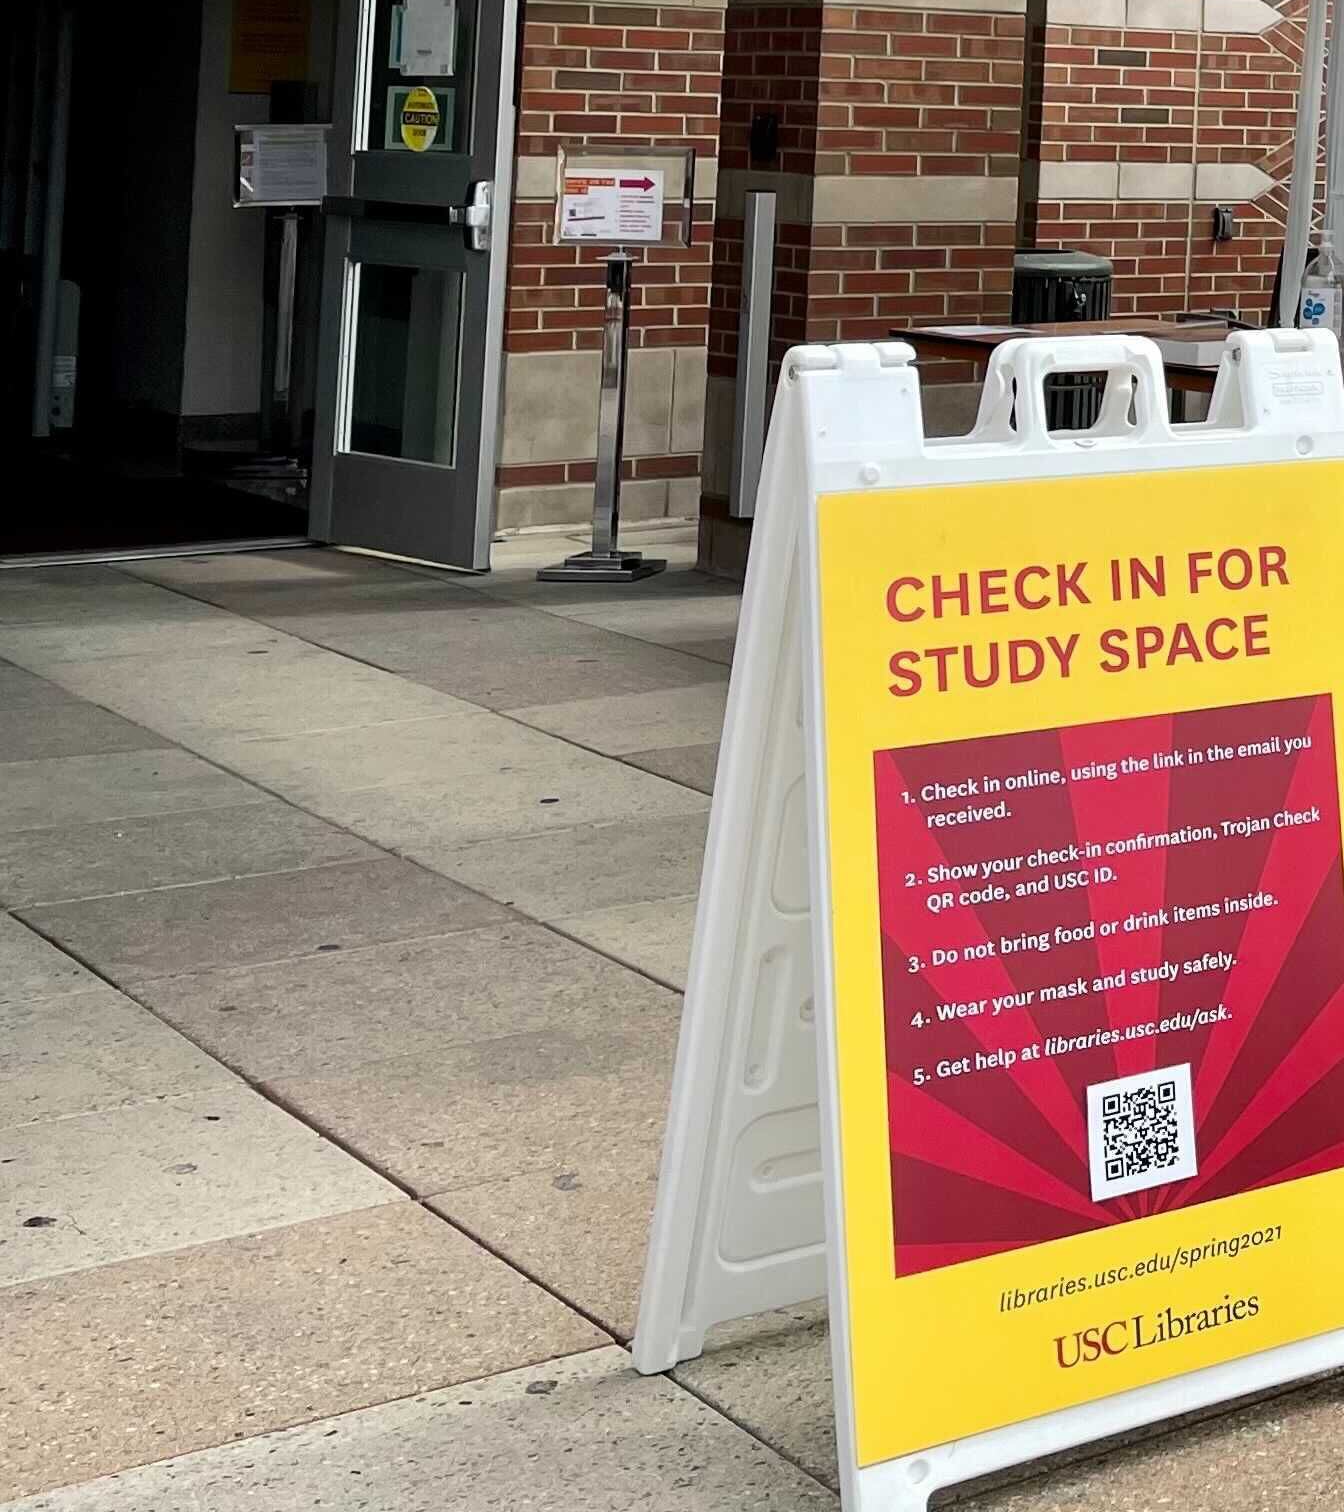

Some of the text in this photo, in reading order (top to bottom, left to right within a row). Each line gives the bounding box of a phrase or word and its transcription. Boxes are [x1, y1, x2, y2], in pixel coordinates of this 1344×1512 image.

[885, 545, 1290, 623] CHECK IN FOR
[887, 614, 1271, 698] STUDY SPACE
[901, 735, 1312, 805] 1. Check in online, using the link in the email you
[905, 806, 1320, 888] 2. Show your check-in confirmation, Trojan Check
[927, 801, 1012, 828] received.
[927, 865, 1117, 913] QR code, and USC ID.
[907, 891, 1279, 973] 3. Do not bring food or drink items inside.
[911, 950, 1237, 1029] 4. Wear your mask and study safely.
[913, 1004, 1234, 1086] 5. Get help at libraries.usc.edu/ask.
[1000, 1225, 1282, 1312] libraries.usc.edu/spring2021
[1054, 1294, 1259, 1368] USC Libraries
